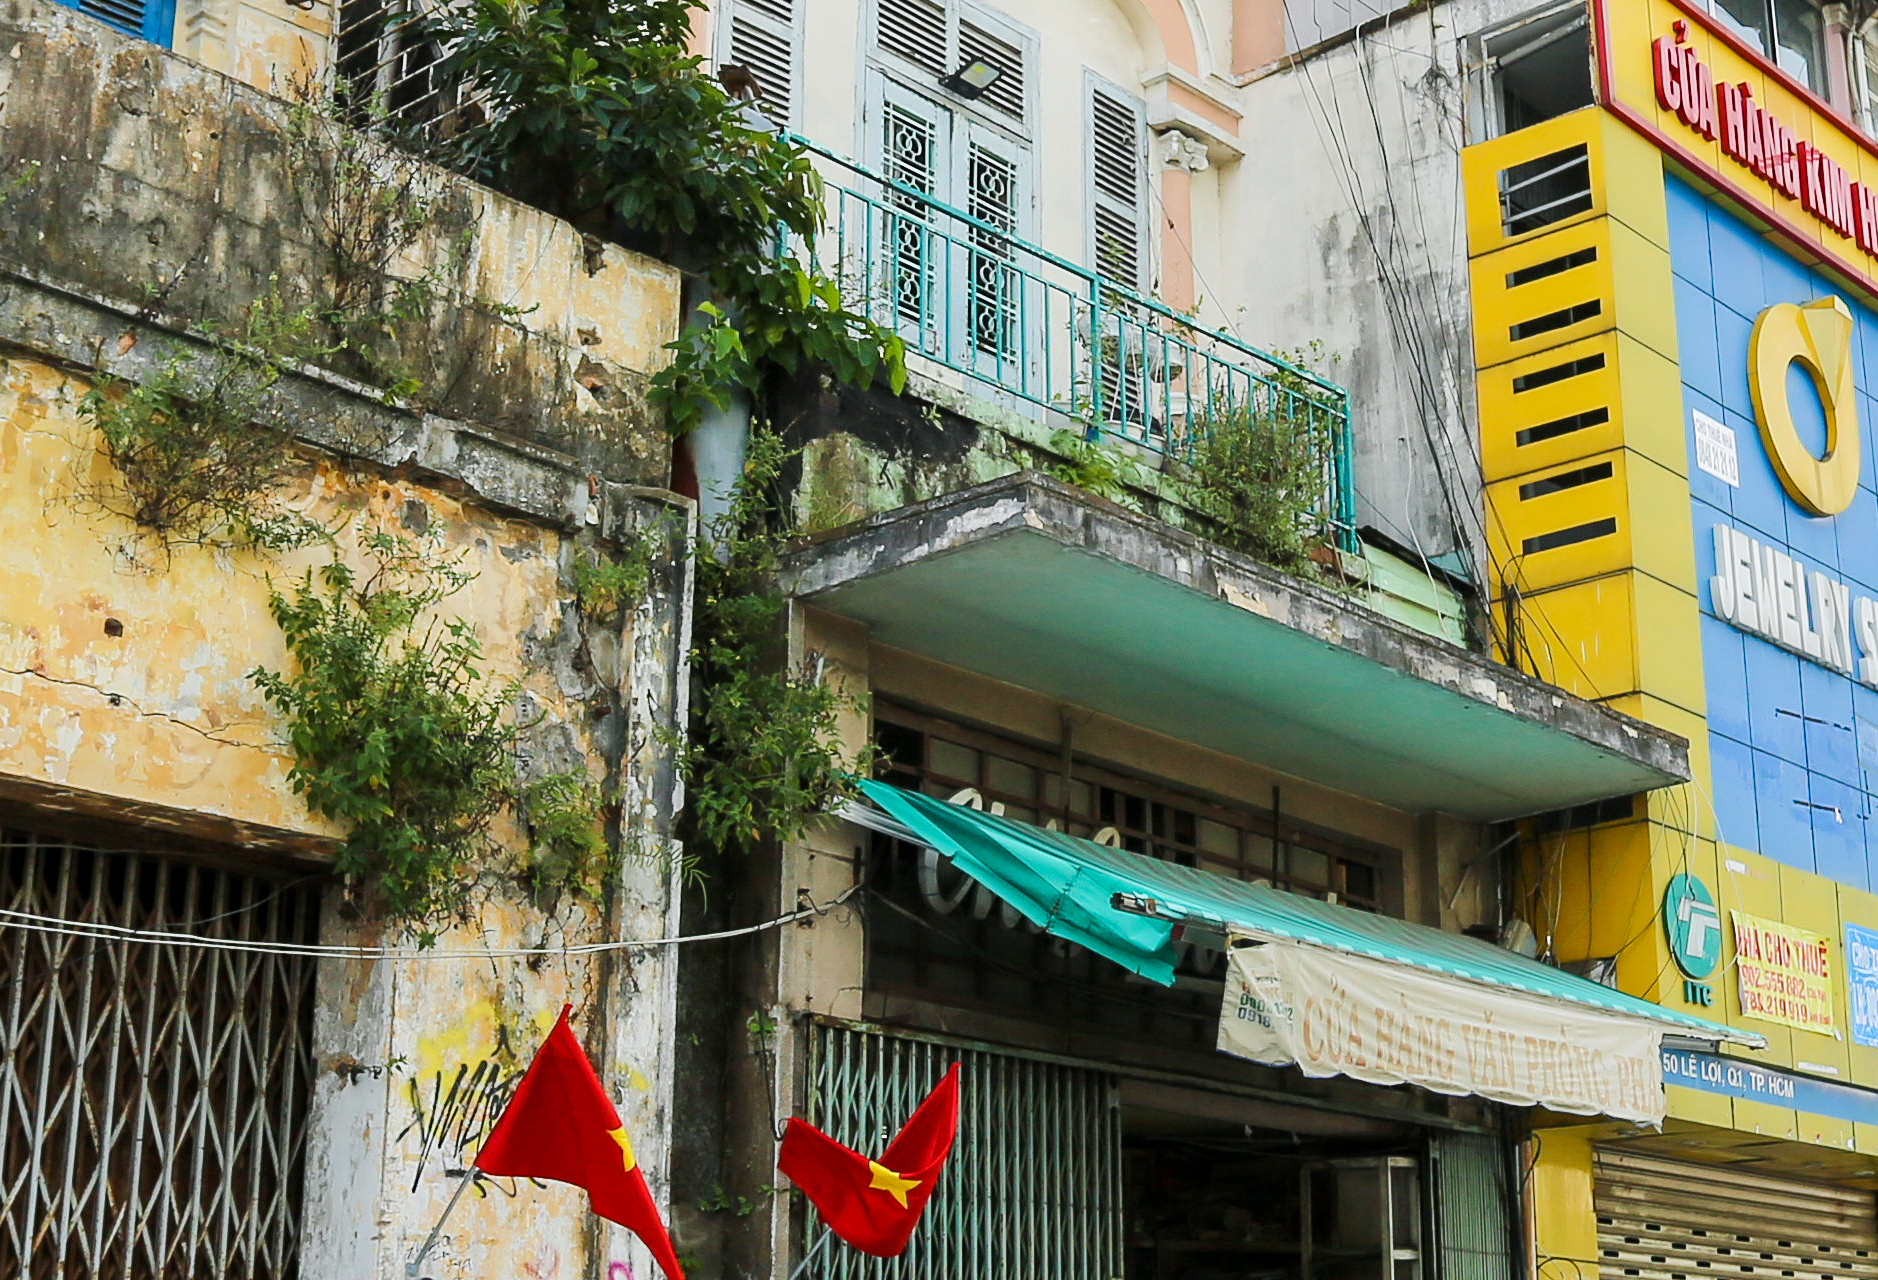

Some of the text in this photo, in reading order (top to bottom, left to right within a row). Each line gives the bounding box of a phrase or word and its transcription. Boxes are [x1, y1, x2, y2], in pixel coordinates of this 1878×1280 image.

[1652, 19, 1718, 142] CỬA
[1716, 81, 1801, 201] HÀNG
[1797, 140, 1855, 239] KIM
[1709, 522, 1854, 675] JEWELRY
[1764, 932, 1792, 968] CHO
[1794, 939, 1828, 978] THUÊ
[1302, 972, 1368, 1066] CỬA
[1374, 991, 1455, 1080] HÀNG
[1461, 1009, 1518, 1088] VĂN
[1663, 1052, 1678, 1075] 50
[1681, 1052, 1698, 1079] LÊ
[1748, 1071, 1766, 1093] TP.
[1768, 1076, 1795, 1099] HCM
